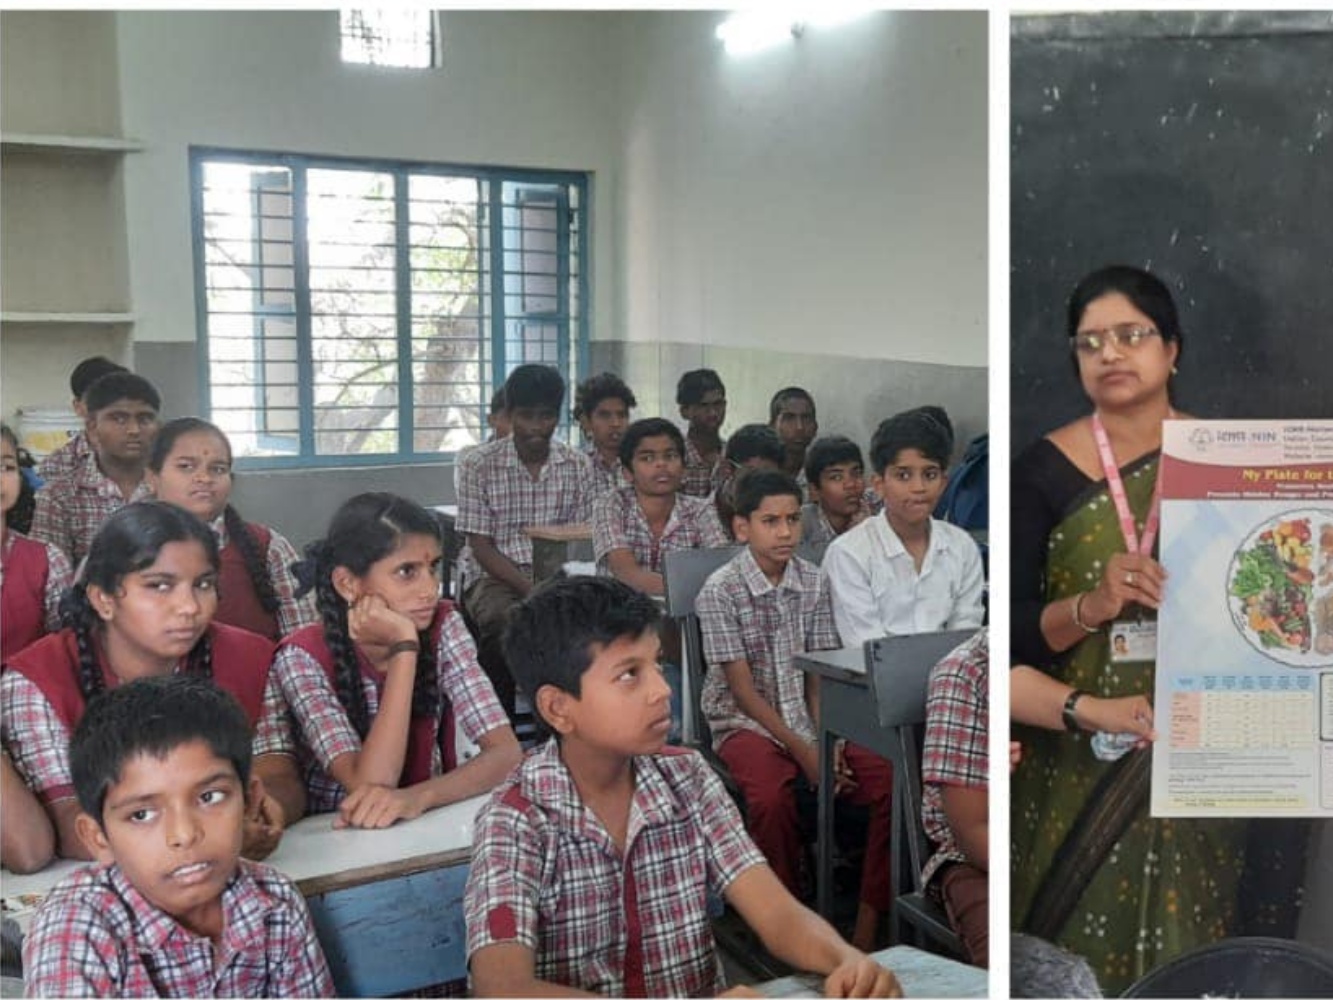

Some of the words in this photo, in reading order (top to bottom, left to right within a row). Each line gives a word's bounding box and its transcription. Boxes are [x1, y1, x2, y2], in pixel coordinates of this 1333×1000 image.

[1242, 468, 1261, 483] My
[1265, 468, 1299, 481] Plate
[1304, 468, 1323, 480] for
